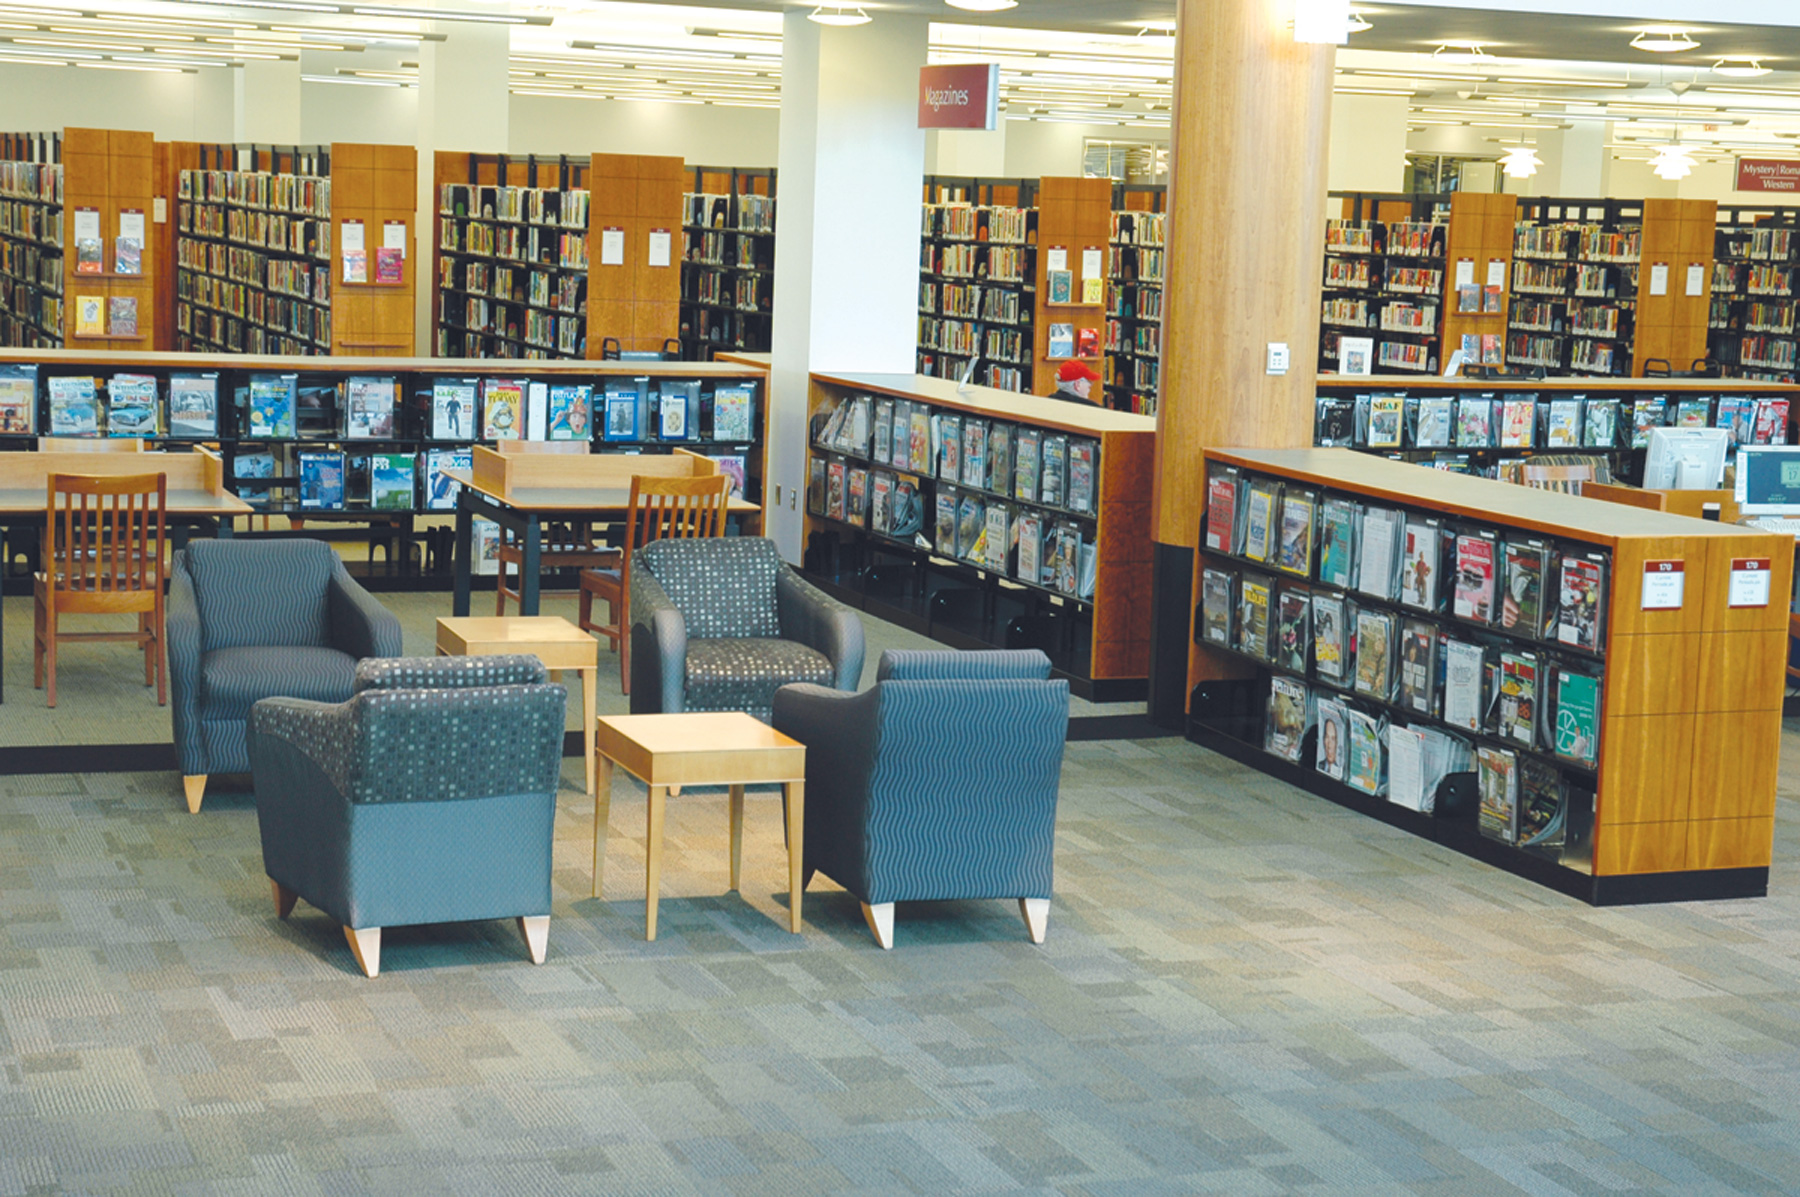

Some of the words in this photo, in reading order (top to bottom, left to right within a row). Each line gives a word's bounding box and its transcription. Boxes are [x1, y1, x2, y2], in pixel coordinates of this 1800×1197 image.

[924, 84, 969, 112] Magazines
[1743, 164, 1776, 176] Mystery
[1763, 179, 1795, 189] Western
[1659, 563, 1673, 571] 170
[1745, 561, 1759, 569] 170
